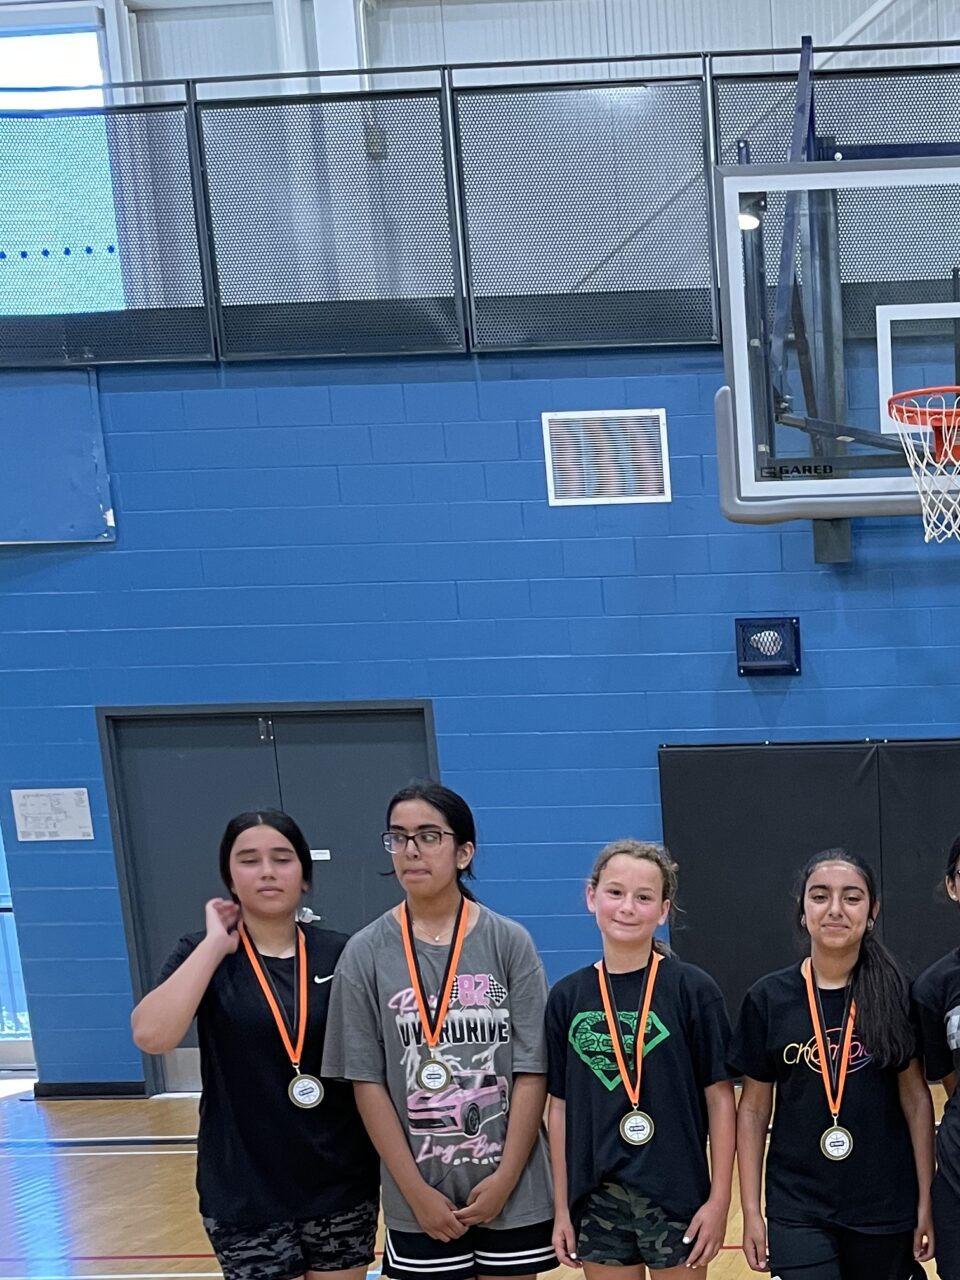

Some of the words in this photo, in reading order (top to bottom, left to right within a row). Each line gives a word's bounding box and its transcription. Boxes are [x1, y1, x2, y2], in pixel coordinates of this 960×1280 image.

[780, 465, 833, 475] GARED
[458, 974, 490, 1006] 82
[395, 1008, 510, 1048] OVRDRIVE
